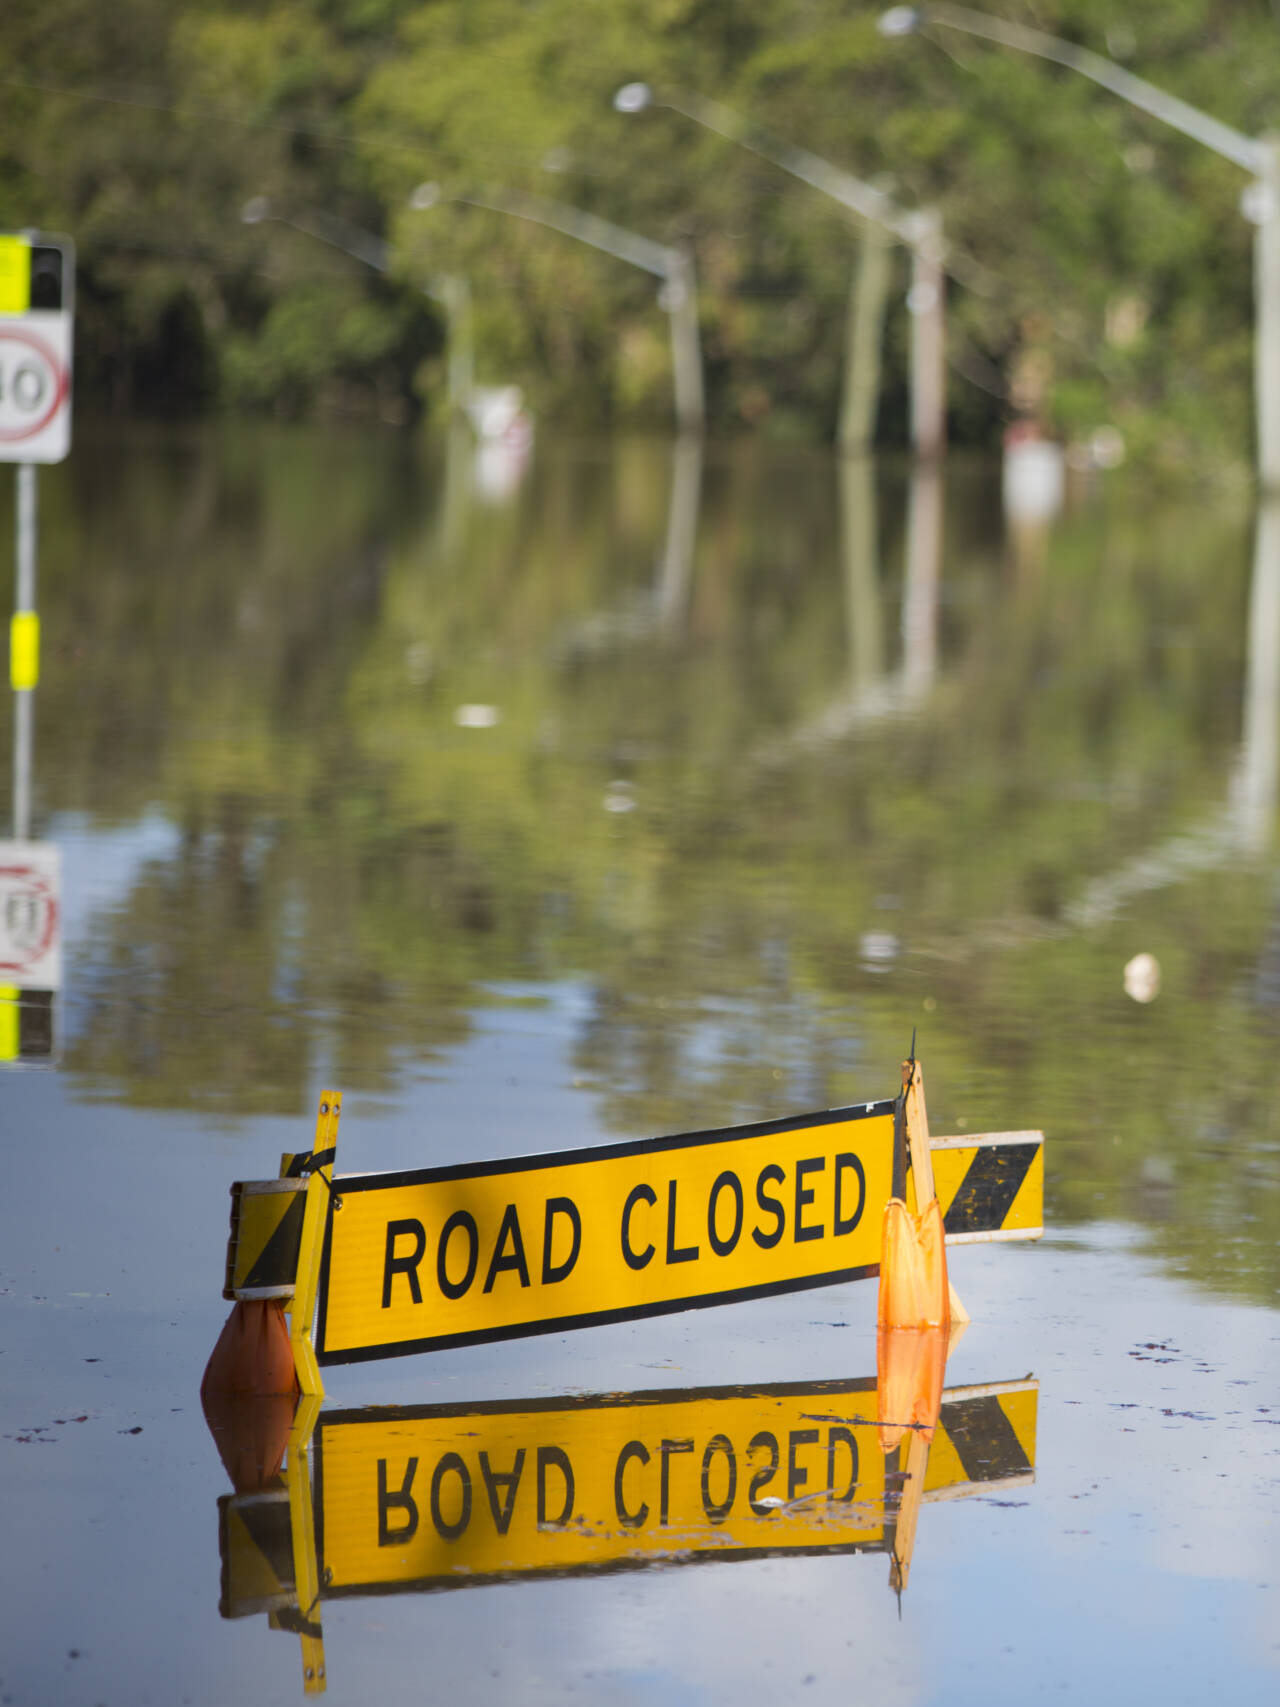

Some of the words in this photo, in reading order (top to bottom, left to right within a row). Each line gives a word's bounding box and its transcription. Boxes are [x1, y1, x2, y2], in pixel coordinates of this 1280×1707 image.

[0, 359, 45, 412] 0
[382, 1197, 582, 1308] ROAD
[620, 1152, 867, 1270] CLOSED
